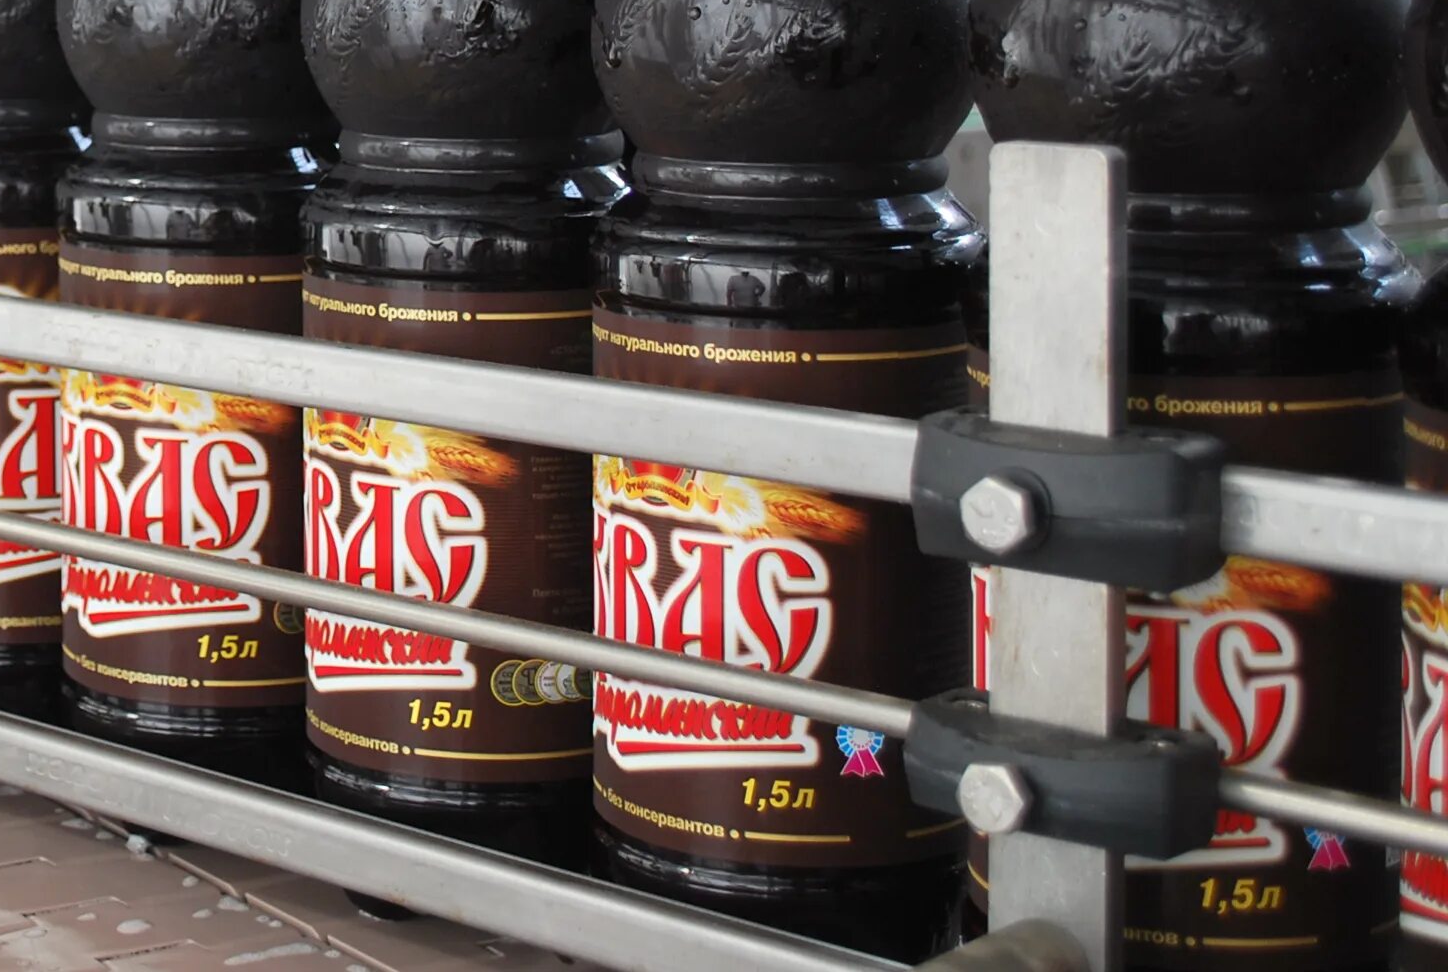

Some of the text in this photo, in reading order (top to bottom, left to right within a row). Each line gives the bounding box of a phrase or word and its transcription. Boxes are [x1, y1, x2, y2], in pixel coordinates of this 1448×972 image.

[166, 269, 243, 287] брожения
[379, 303, 458, 322] брожения
[610, 333, 700, 358] натурального
[704, 343, 796, 363] брожения
[1155, 395, 1263, 417] брожения
[197, 633, 259, 663] 1,5л
[97, 663, 190, 689] консервантов
[409, 698, 473, 730] 1,5л
[319, 720, 399, 754] консервантов
[742, 778, 815, 812] 1,5л
[608, 787, 724, 838] без консервантов
[1200, 878, 1281, 915] 1,5л
